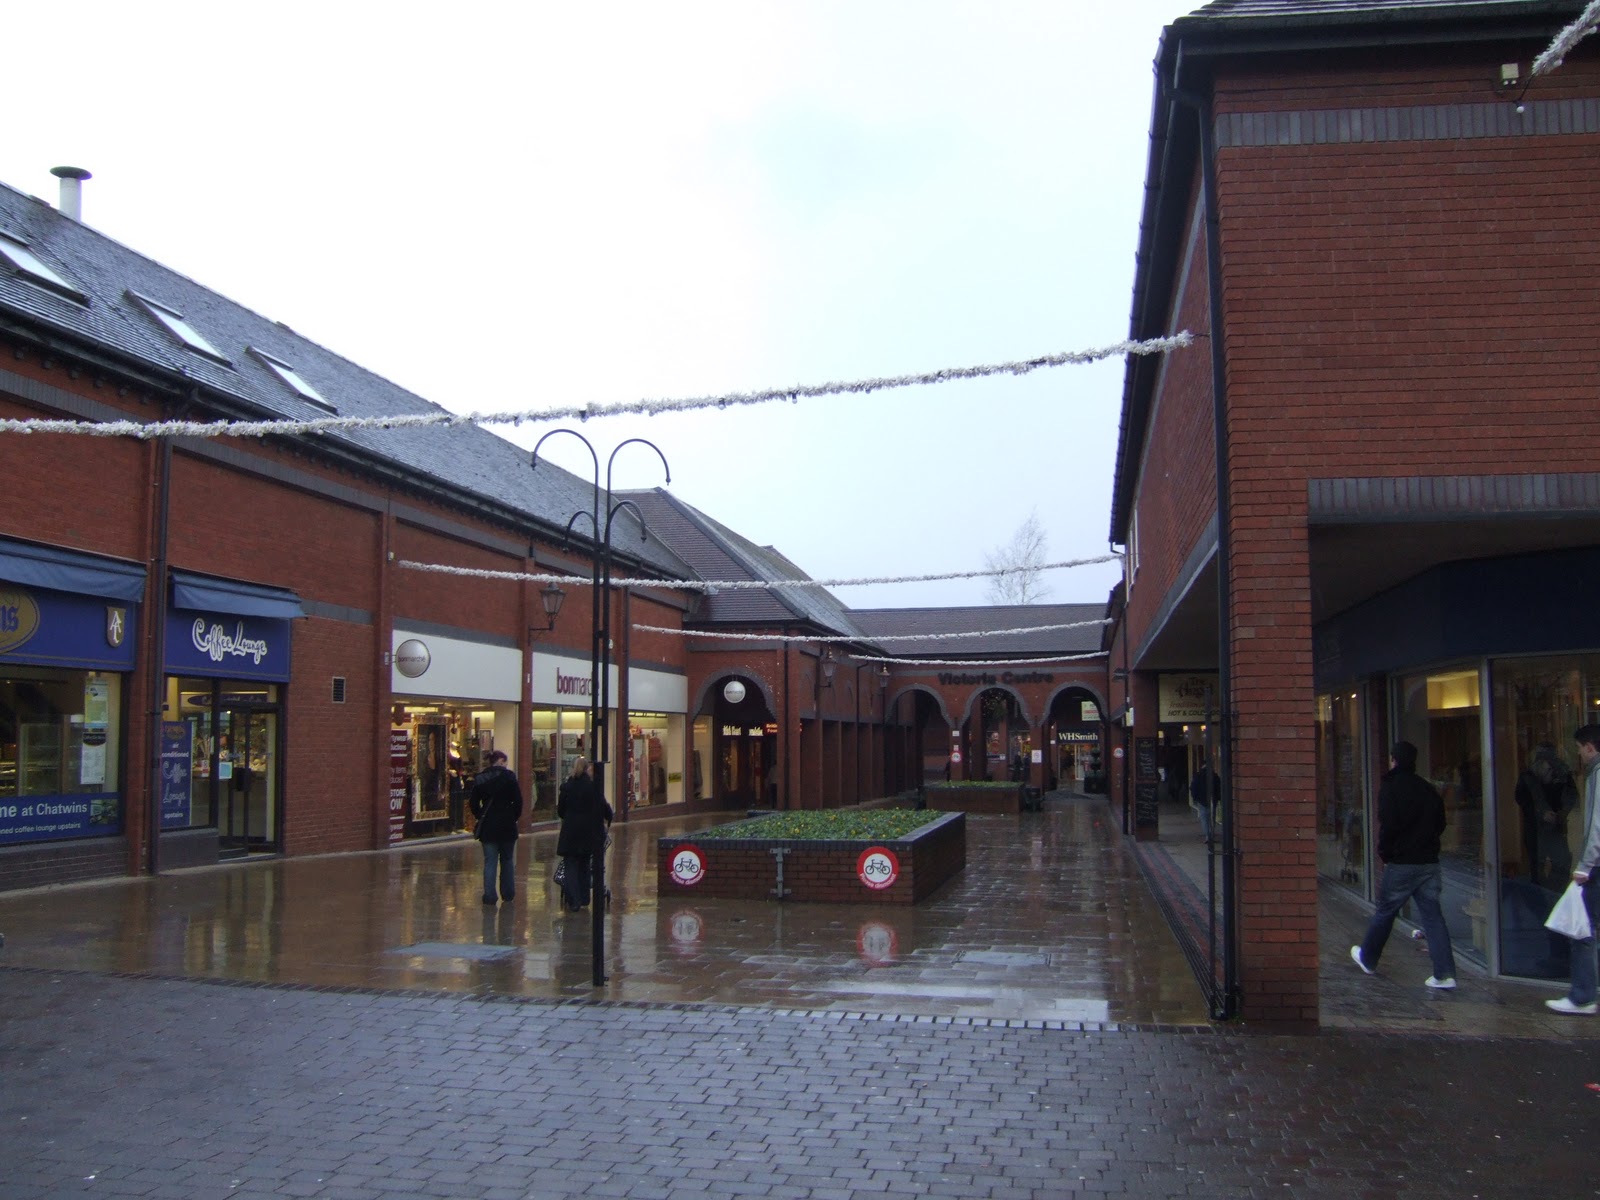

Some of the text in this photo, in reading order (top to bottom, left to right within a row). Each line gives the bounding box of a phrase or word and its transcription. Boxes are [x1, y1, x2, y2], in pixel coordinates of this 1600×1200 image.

[192, 617, 268, 665] Coffee Lounge
[937, 671, 1054, 685] Victoria Centre
[1058, 732, 1098, 741] WHSmith
[21, 804, 34, 817] at
[36, 801, 88, 816] Chatwins
[35, 823, 57, 833] lounge
[57, 821, 82, 831] upstairs
